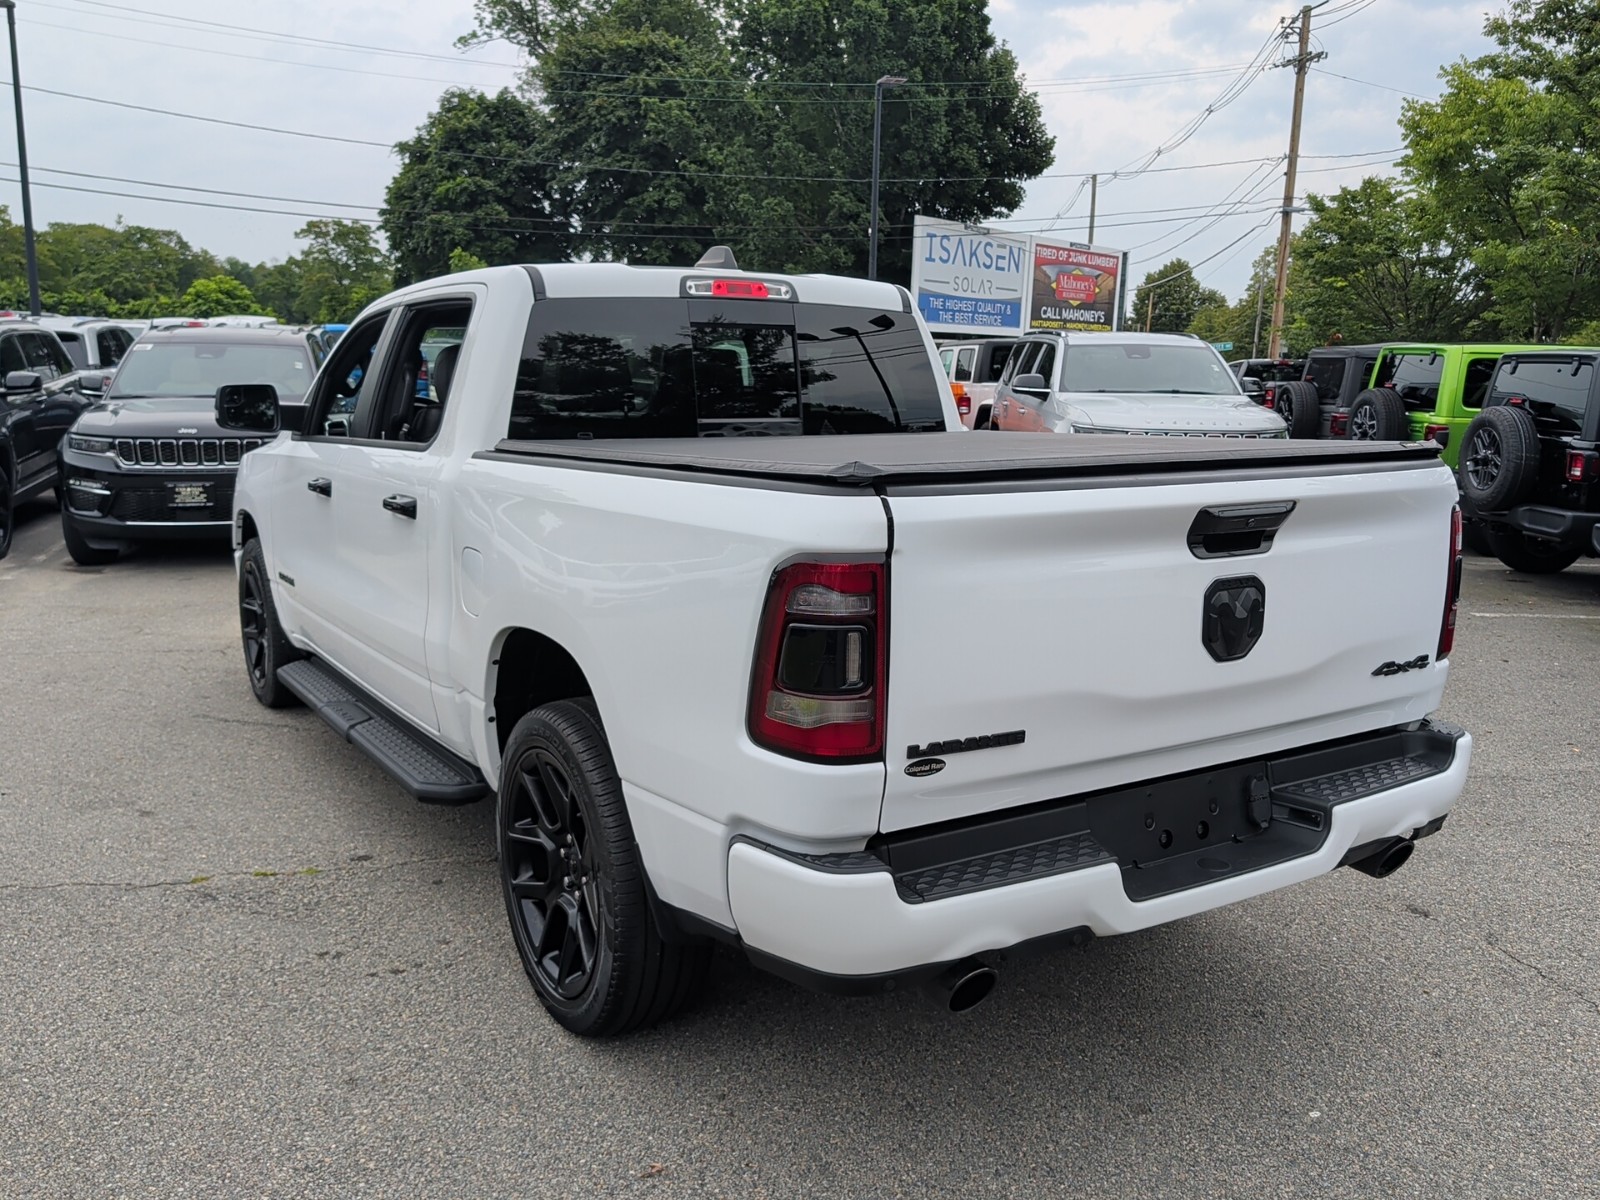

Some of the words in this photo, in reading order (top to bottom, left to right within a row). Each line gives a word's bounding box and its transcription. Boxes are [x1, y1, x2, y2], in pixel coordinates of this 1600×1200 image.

[925, 232, 1021, 273] ISAKSEN
[1036, 246, 1057, 259] TIRED
[1058, 250, 1068, 261] OF
[1069, 251, 1087, 264] JUNK
[1088, 254, 1117, 268] LUMBER?
[953, 275, 993, 295] SOLAR
[1058, 275, 1094, 292] Mahoney's
[930, 298, 944, 309] THE
[945, 299, 976, 312] HIGHEST
[977, 302, 1005, 314] QUALITY
[1006, 305, 1011, 314] &
[1041, 306, 1060, 319] CALL
[1062, 308, 1105, 322] MAHONEY'S
[939, 311, 953, 323] THE
[955, 313, 973, 324] BEST
[974, 315, 1002, 326] SERVICE
[906, 730, 1026, 759] LARAMIE
[905, 764, 930, 773] Colonial
